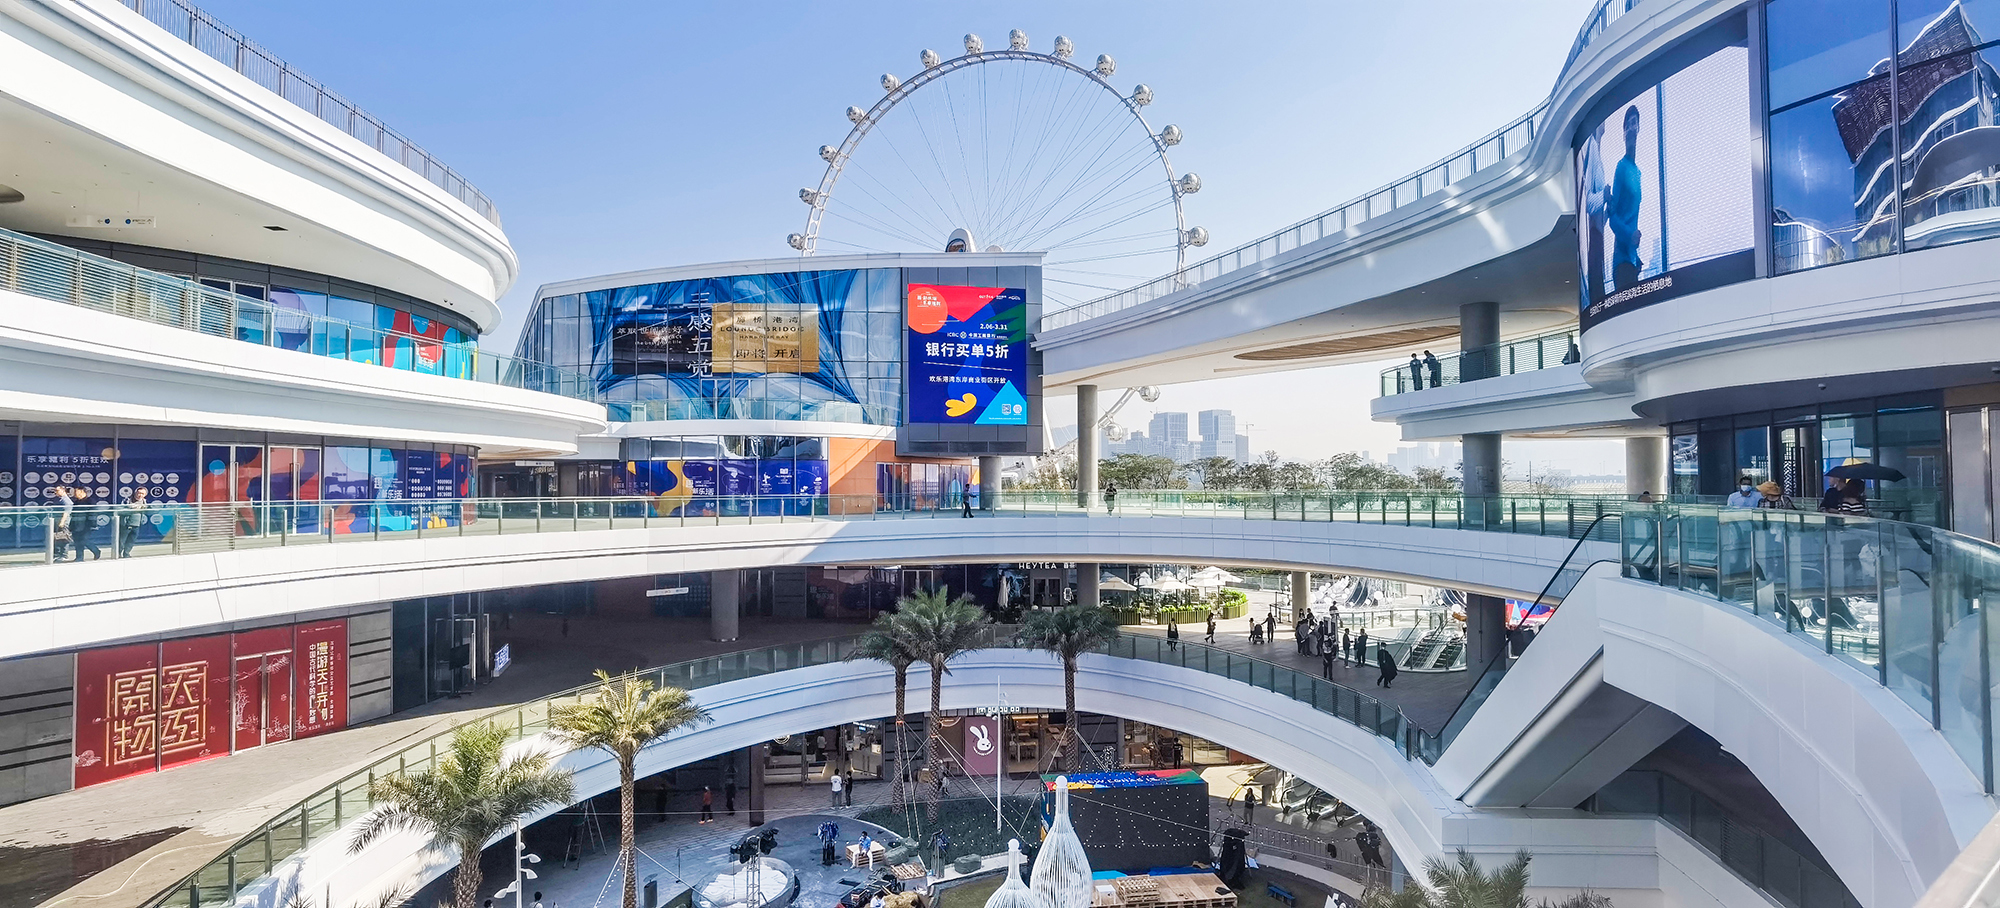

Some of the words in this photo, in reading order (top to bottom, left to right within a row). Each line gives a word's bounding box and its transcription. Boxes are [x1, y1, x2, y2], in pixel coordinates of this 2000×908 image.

[979, 323, 1008, 331] 2.06-3.31
[925, 341, 1009, 359] 银行买单5折
[1018, 562, 1058, 570] HEYTEA
